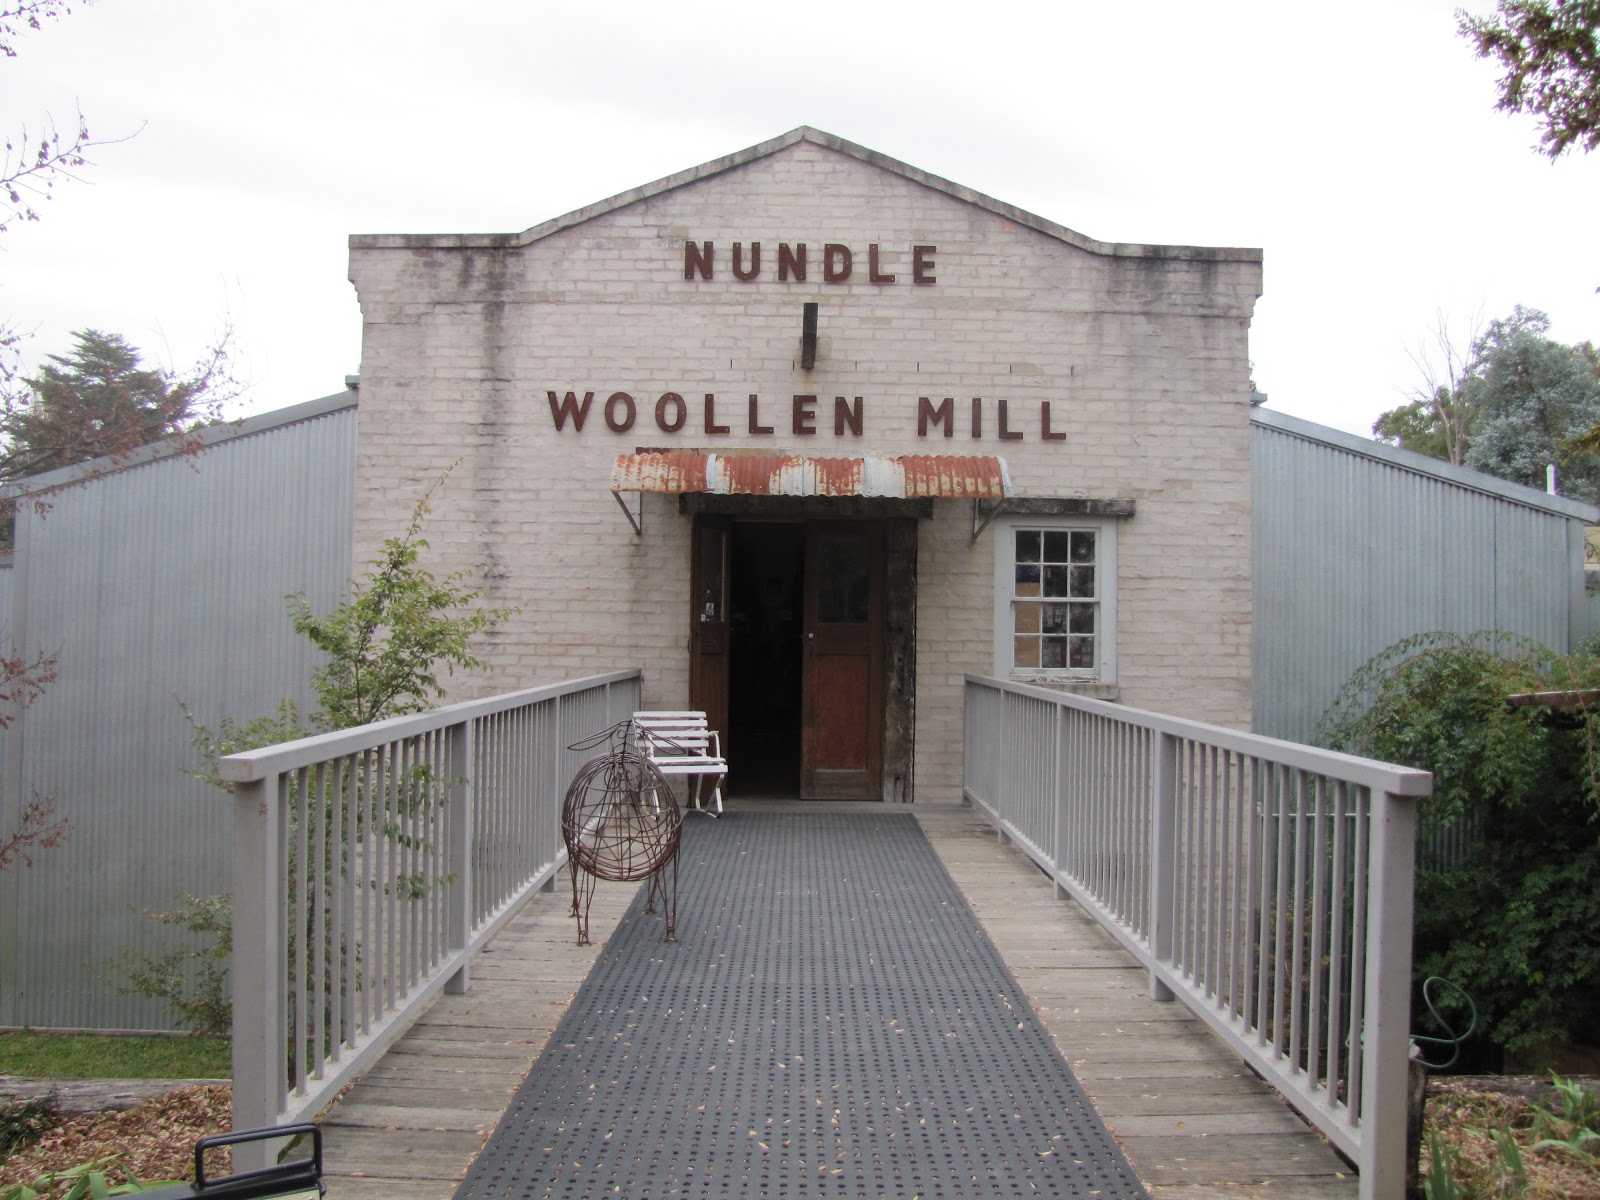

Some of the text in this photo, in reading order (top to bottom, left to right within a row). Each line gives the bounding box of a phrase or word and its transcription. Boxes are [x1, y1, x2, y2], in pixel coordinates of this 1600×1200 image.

[684, 240, 937, 284] NUNDLE
[547, 391, 1067, 441] WOOLLEN MILL
